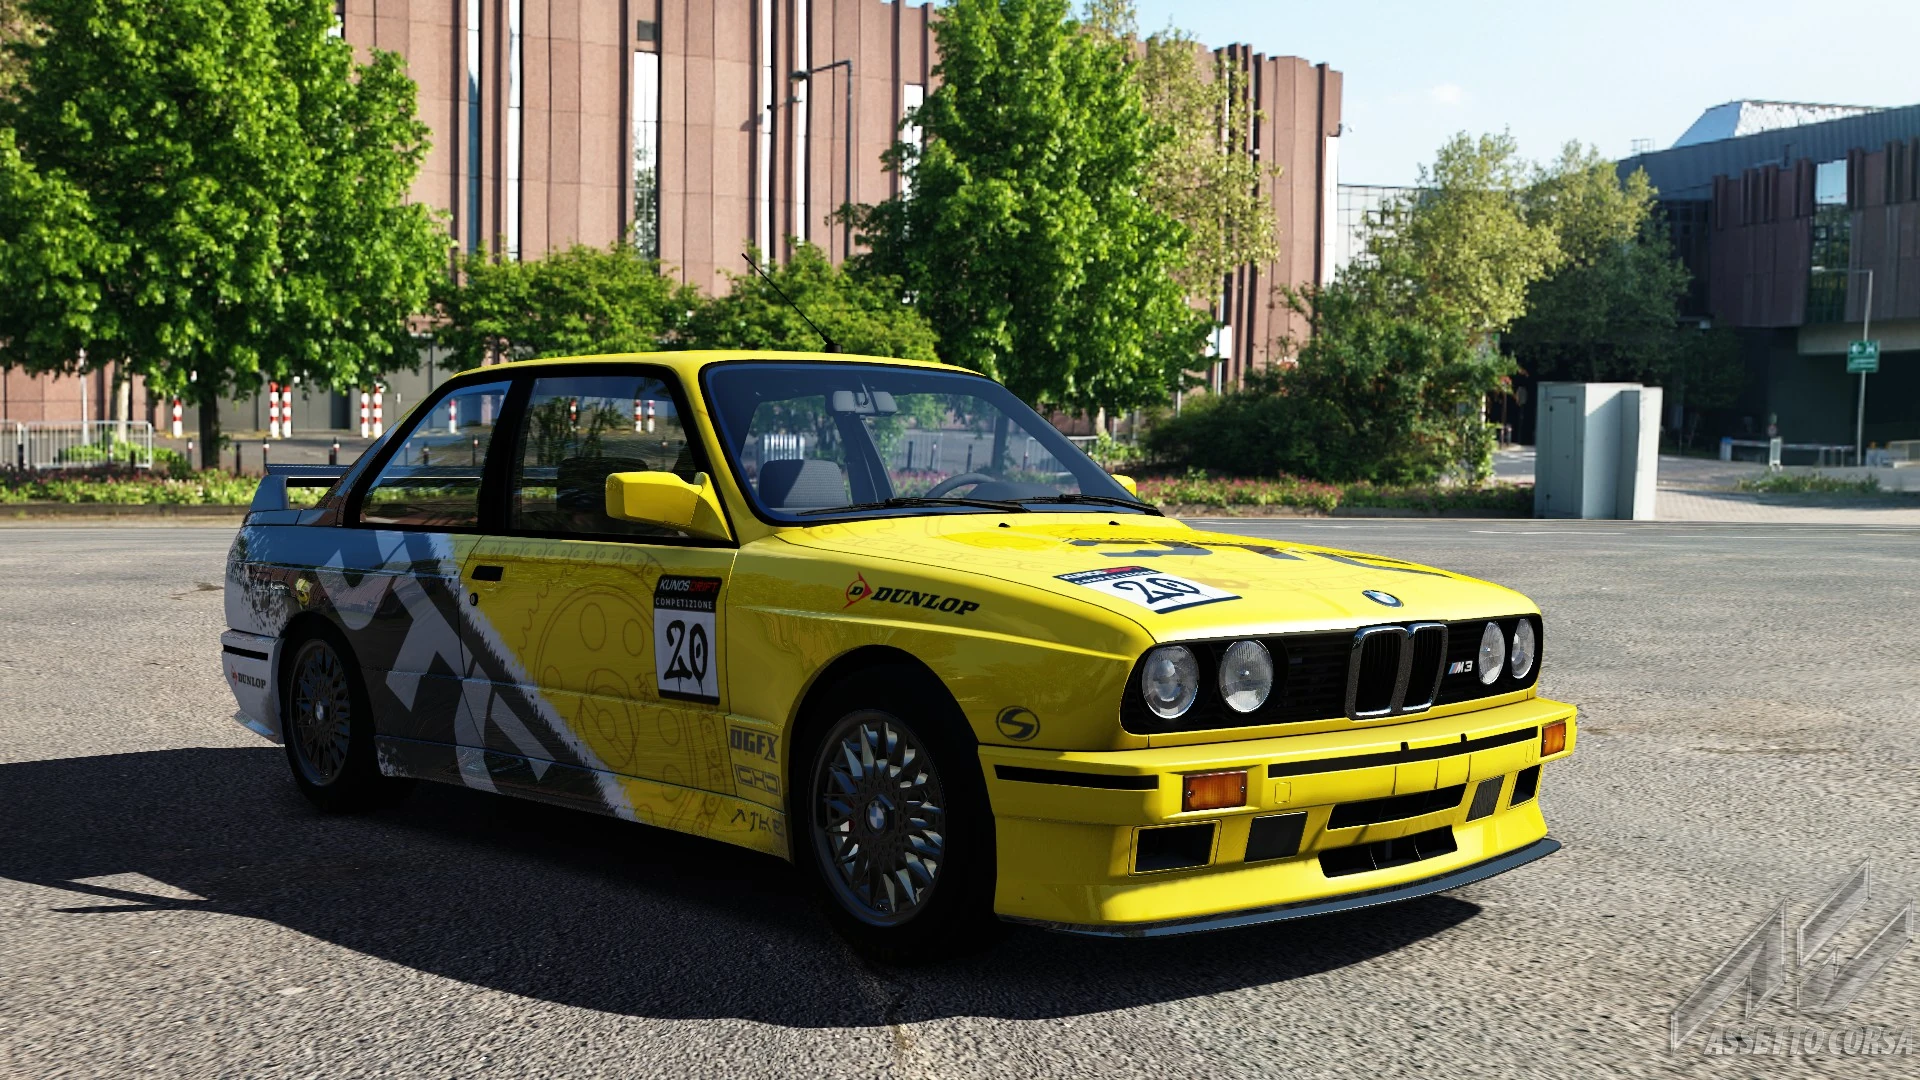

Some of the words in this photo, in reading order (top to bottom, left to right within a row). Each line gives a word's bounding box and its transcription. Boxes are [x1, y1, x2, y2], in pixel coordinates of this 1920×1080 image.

[871, 586, 980, 616] DUNLOP
[1112, 578, 1201, 605] 20
[655, 597, 713, 610] COMPETIZIONE
[664, 620, 709, 682] 20
[1453, 660, 1474, 674] M3
[238, 672, 267, 689] DUNLOP
